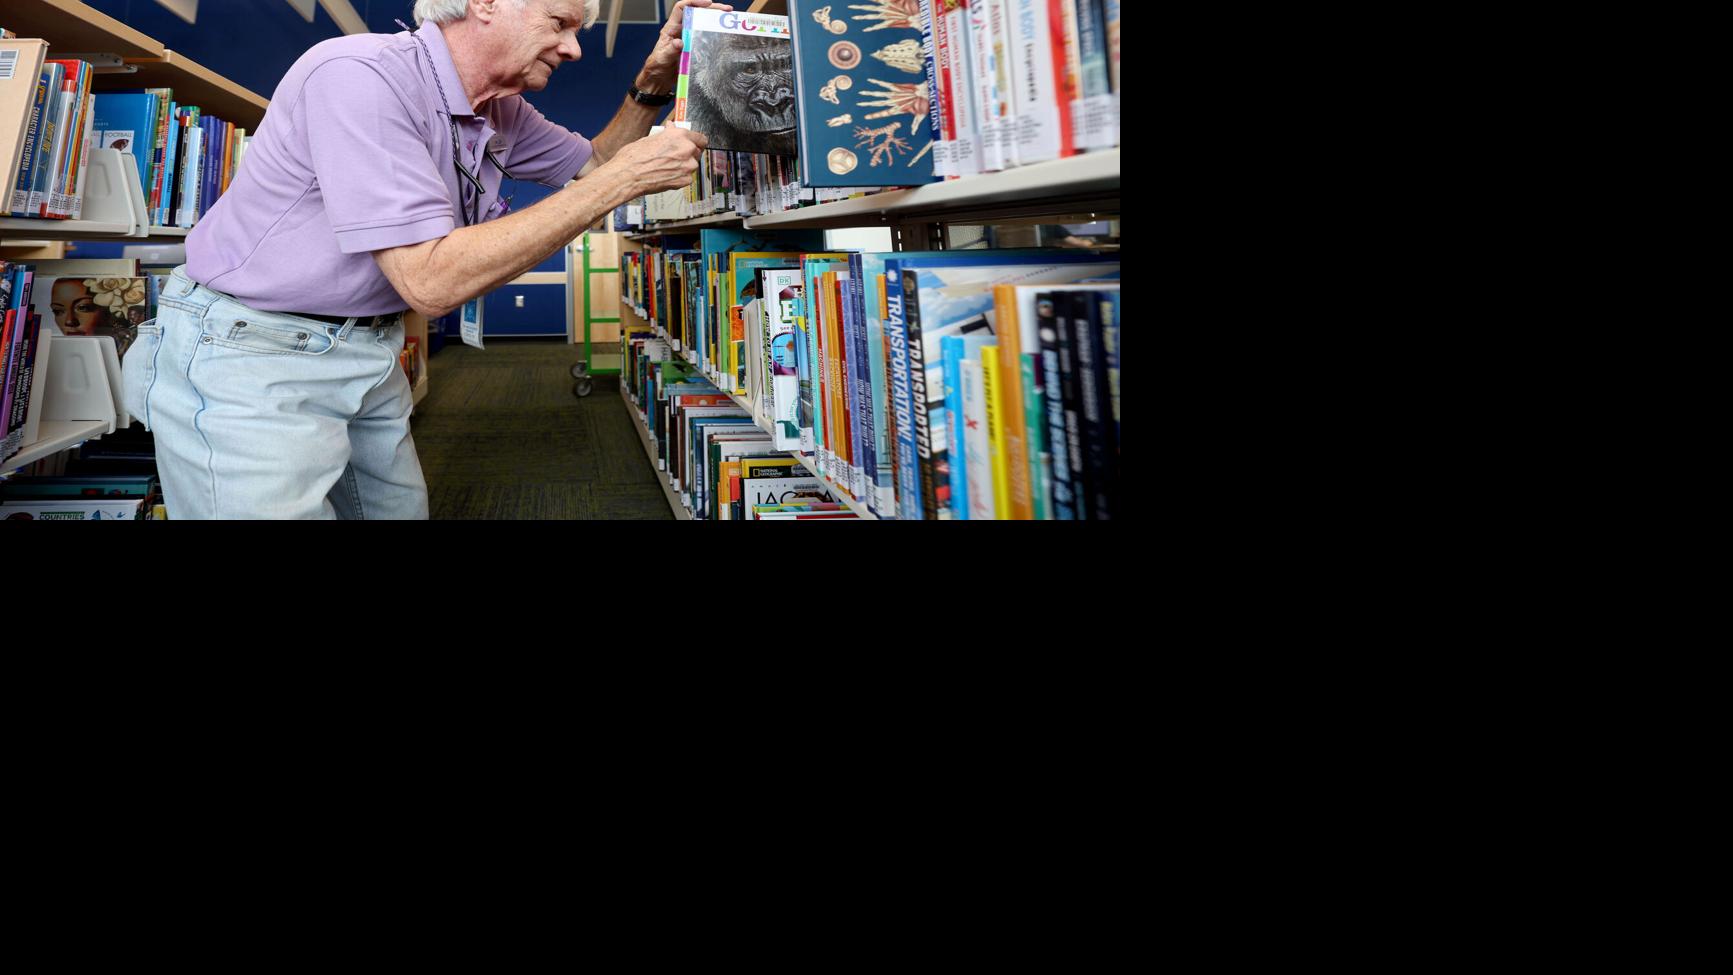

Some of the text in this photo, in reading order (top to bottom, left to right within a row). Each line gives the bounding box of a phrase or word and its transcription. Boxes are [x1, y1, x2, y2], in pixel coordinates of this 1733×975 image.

[922, 37, 934, 58] BODY
[937, 15, 947, 46] HUMAN
[940, 48, 949, 69] BODY
[926, 61, 940, 131] CROSS-SECTIONS
[21, 106, 41, 171] CHARACTER ENCYCLOPEDIA
[887, 294, 912, 441] TRANSPORTATION!
[1043, 350, 1062, 400] BEHIND
[907, 338, 930, 459] TRANSPORTED
[1049, 401, 1066, 425] THE
[1050, 427, 1070, 481] SCENES
[40, 512, 85, 520] COUNTRIES
